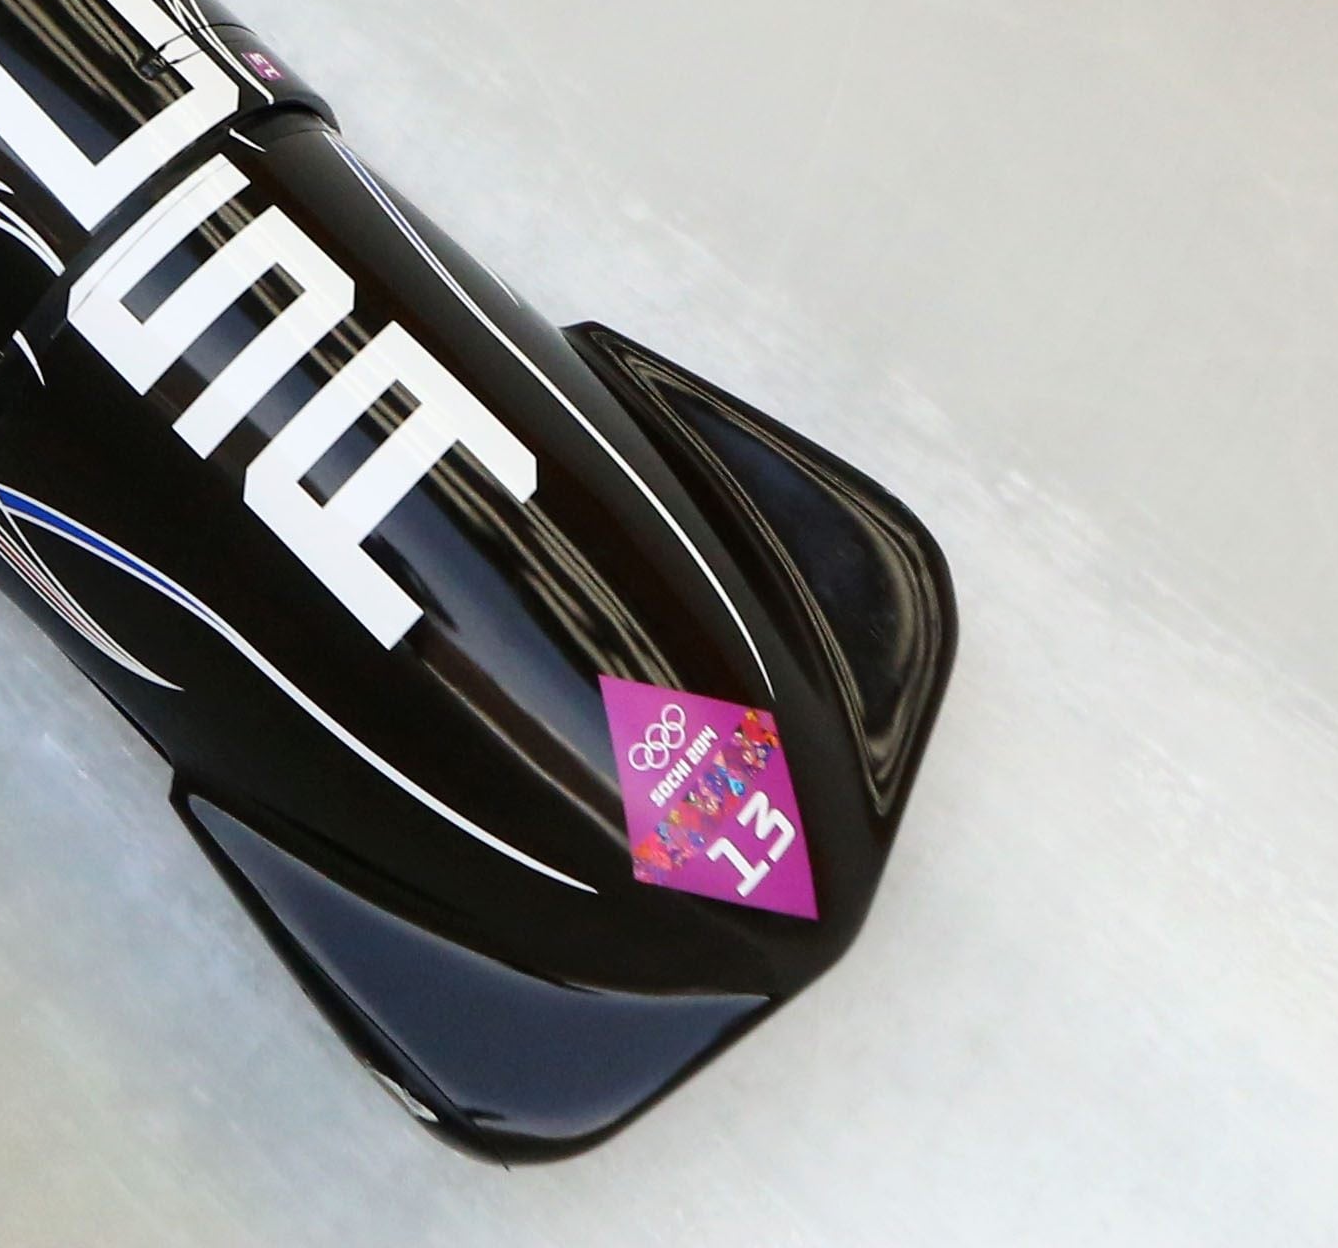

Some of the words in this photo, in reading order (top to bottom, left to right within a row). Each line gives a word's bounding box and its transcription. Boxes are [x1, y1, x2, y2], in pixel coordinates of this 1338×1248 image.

[649, 758, 693, 808] SOCHI
[685, 724, 719, 766] 2014
[706, 790, 796, 897] 13
